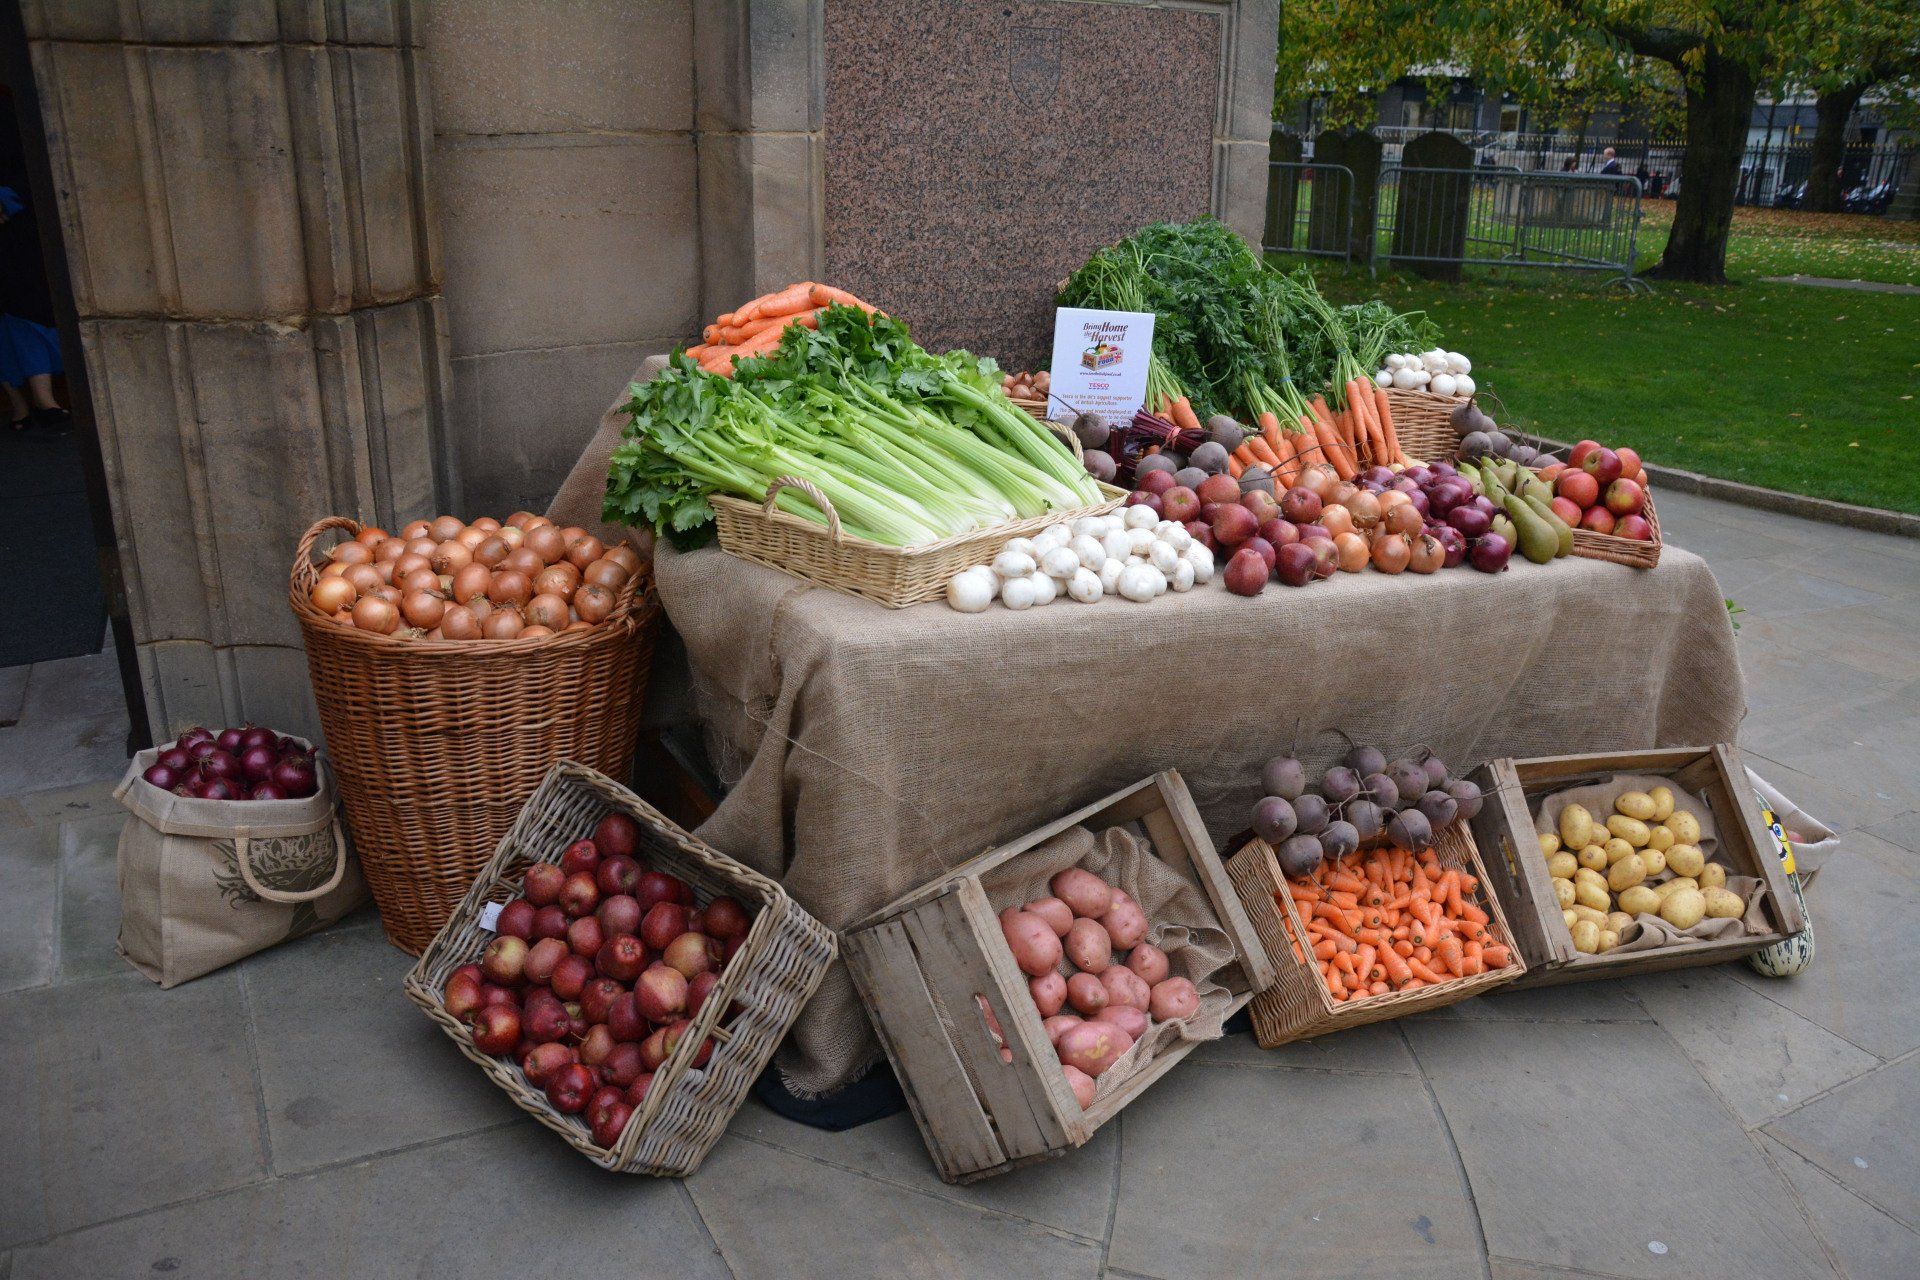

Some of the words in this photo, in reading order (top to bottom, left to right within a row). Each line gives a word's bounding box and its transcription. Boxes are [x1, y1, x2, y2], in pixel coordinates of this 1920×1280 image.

[1084, 322, 1102, 330] Bring
[1102, 322, 1128, 332] Home
[1090, 331, 1125, 342] Harvest
